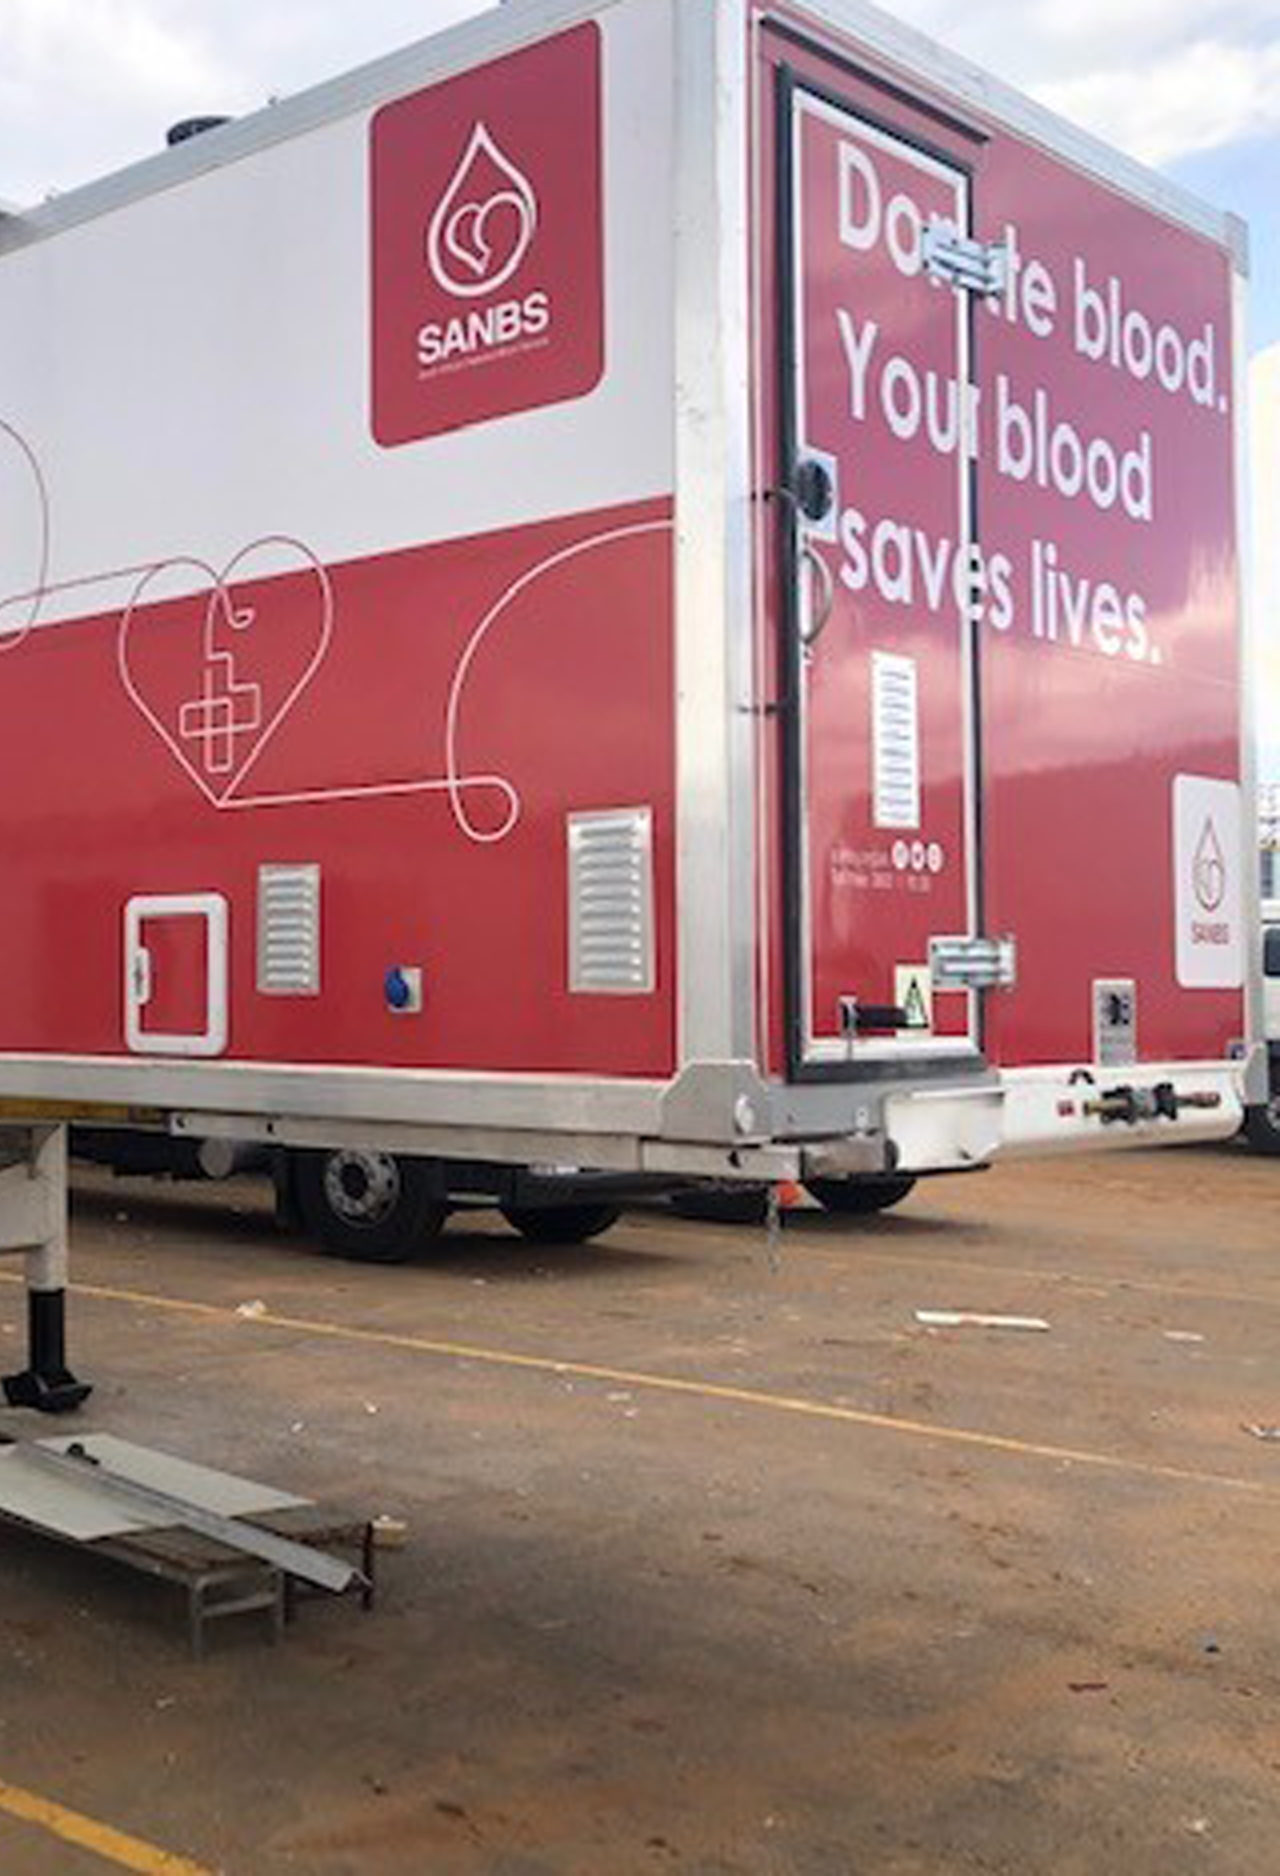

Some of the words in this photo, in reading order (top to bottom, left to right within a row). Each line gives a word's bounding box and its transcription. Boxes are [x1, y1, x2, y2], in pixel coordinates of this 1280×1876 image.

[416, 290, 550, 365] SANBS
[838, 139, 1057, 338] Dote
[1074, 257, 1228, 414] blood.
[836, 308, 980, 459] Your
[995, 374, 1153, 522] blood
[839, 506, 1014, 631] saves
[1031, 540, 1161, 665] lives.
[1190, 922, 1230, 945] SANBS
